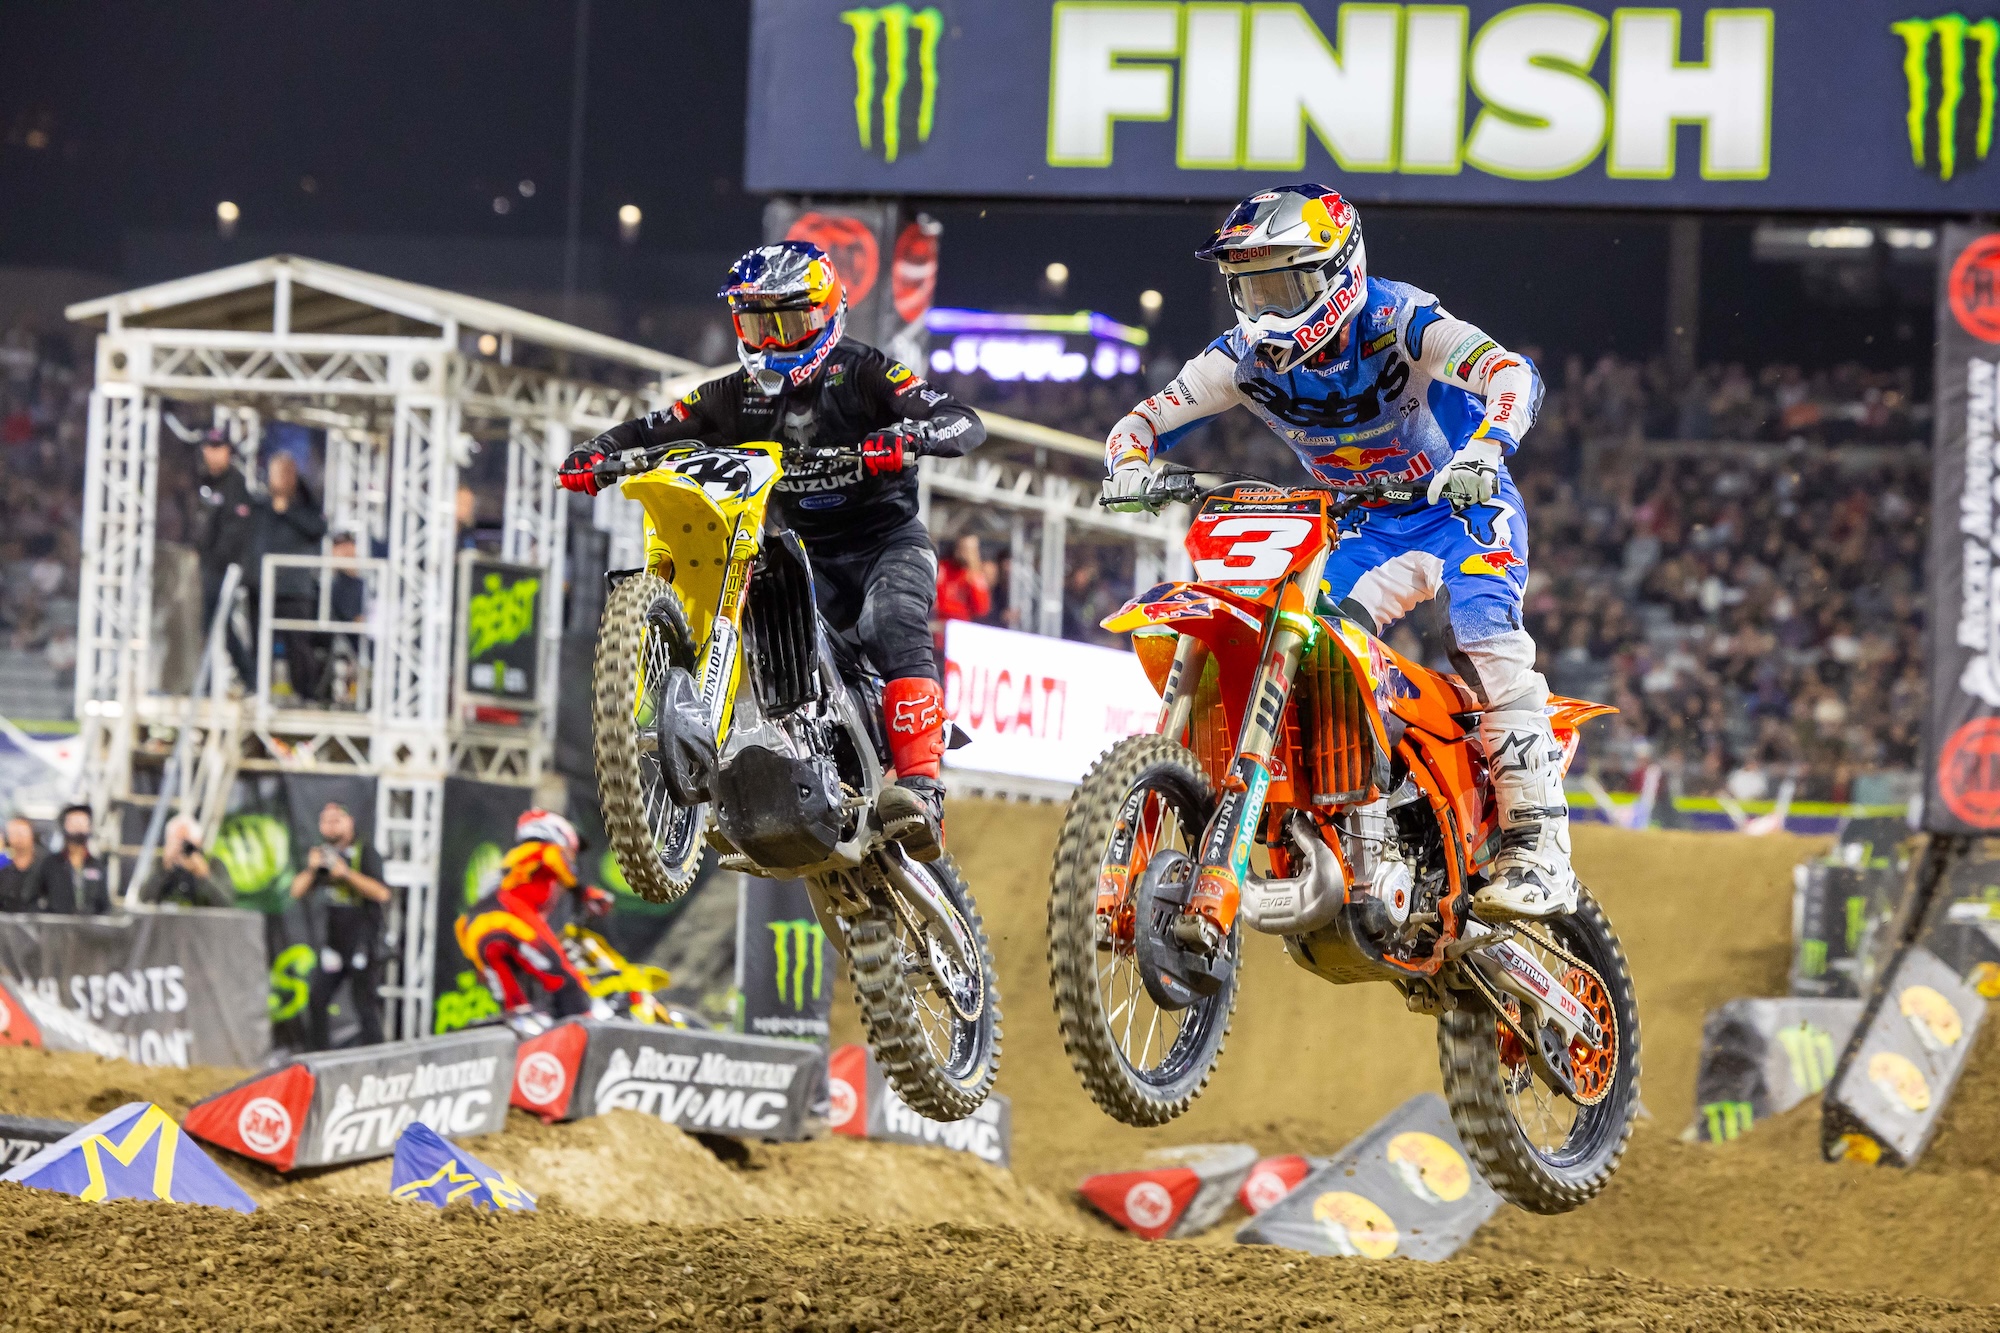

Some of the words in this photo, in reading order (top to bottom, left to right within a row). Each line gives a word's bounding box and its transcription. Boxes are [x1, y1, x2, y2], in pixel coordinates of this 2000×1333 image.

[1047, 1, 1775, 181] FINISH
[1229, 250, 1249, 262] Red
[1250, 246, 1271, 259] Bull
[1294, 300, 1340, 351] Red
[1335, 264, 1363, 313] Bull
[791, 355, 821, 385] Red
[1355, 421, 1397, 440] MOTOREX
[1494, 403, 1513, 423] Red
[775, 470, 864, 493] SUZUKI
[1194, 517, 1313, 582] 3
[724, 563, 740, 607] REP
[1231, 587, 1261, 596] OTOREX
[702, 645, 724, 707] DUNLOP
[945, 659, 1067, 740] DUCATI
[1213, 765, 1244, 846] DUNLP
[1240, 774, 1269, 845] MOTOREX
[71, 964, 188, 1020] SPORTS
[632, 1045, 700, 1083] ROCKY
[693, 1051, 799, 1090] MOUNTAIN
